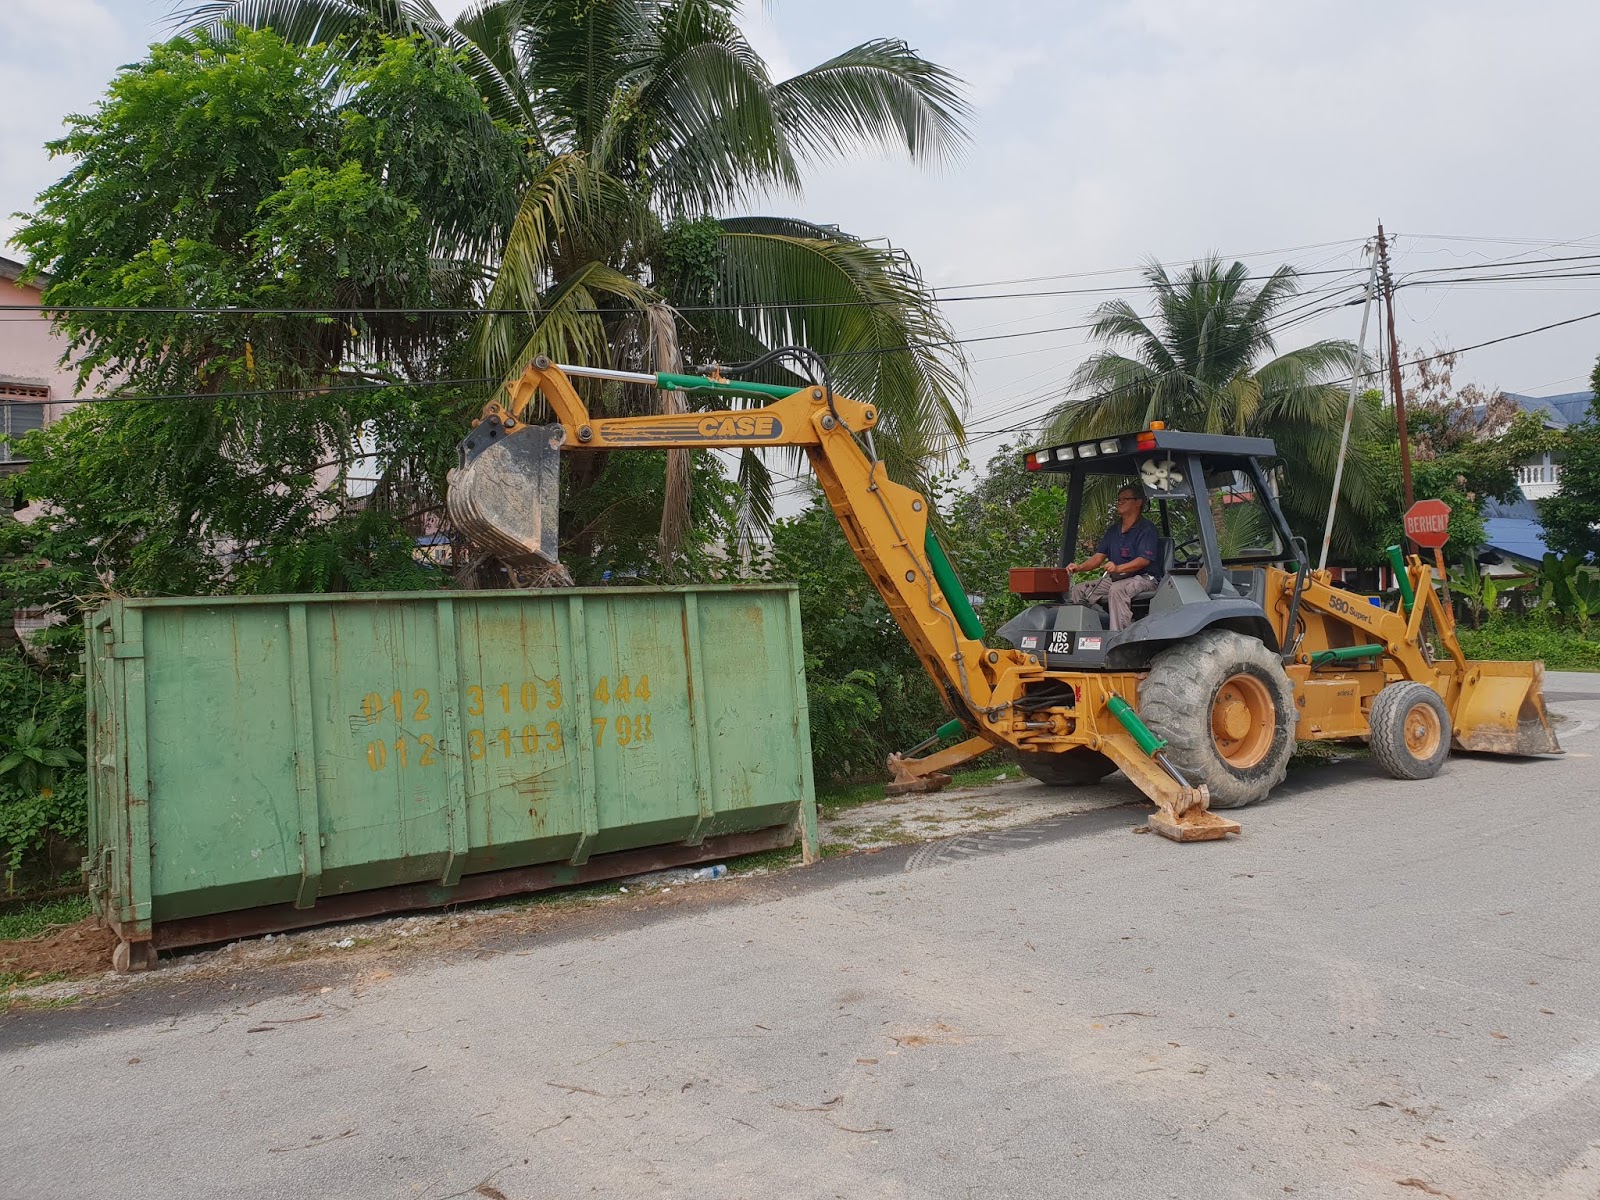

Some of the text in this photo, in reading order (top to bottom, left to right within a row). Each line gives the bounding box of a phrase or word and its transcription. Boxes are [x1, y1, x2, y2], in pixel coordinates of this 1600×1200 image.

[698, 416, 774, 437] CASE
[1329, 594, 1373, 625] 580 Super L
[1048, 643, 1069, 653] 4422
[1052, 631, 1068, 643] VBS
[362, 674, 651, 725] 012 3103 444
[367, 713, 653, 773] 012 3103 798
